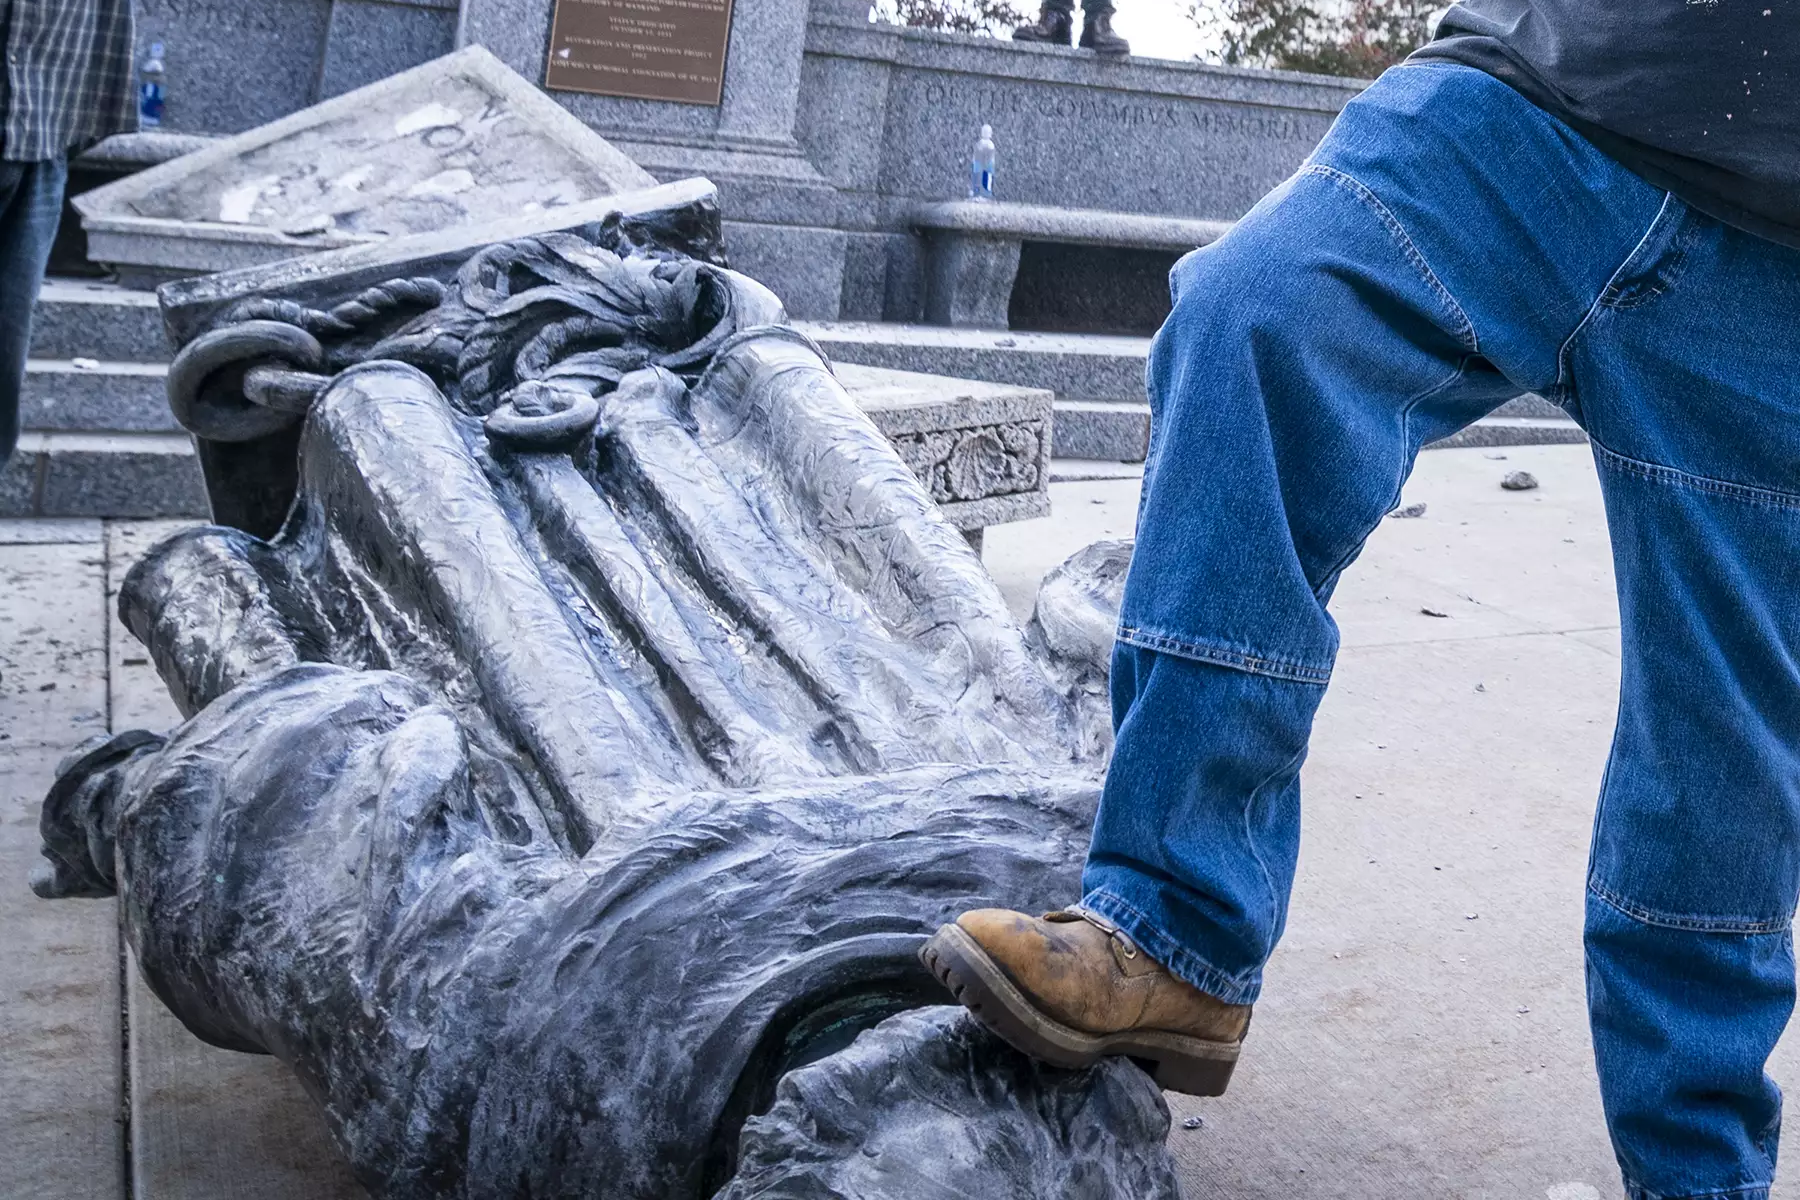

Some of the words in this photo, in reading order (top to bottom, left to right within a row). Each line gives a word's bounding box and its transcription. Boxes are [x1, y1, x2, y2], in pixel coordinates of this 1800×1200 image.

[977, 88, 1023, 113] THE
[1038, 96, 1178, 128] COLVMBVS
[1191, 110, 1317, 142] MEMORIAL
